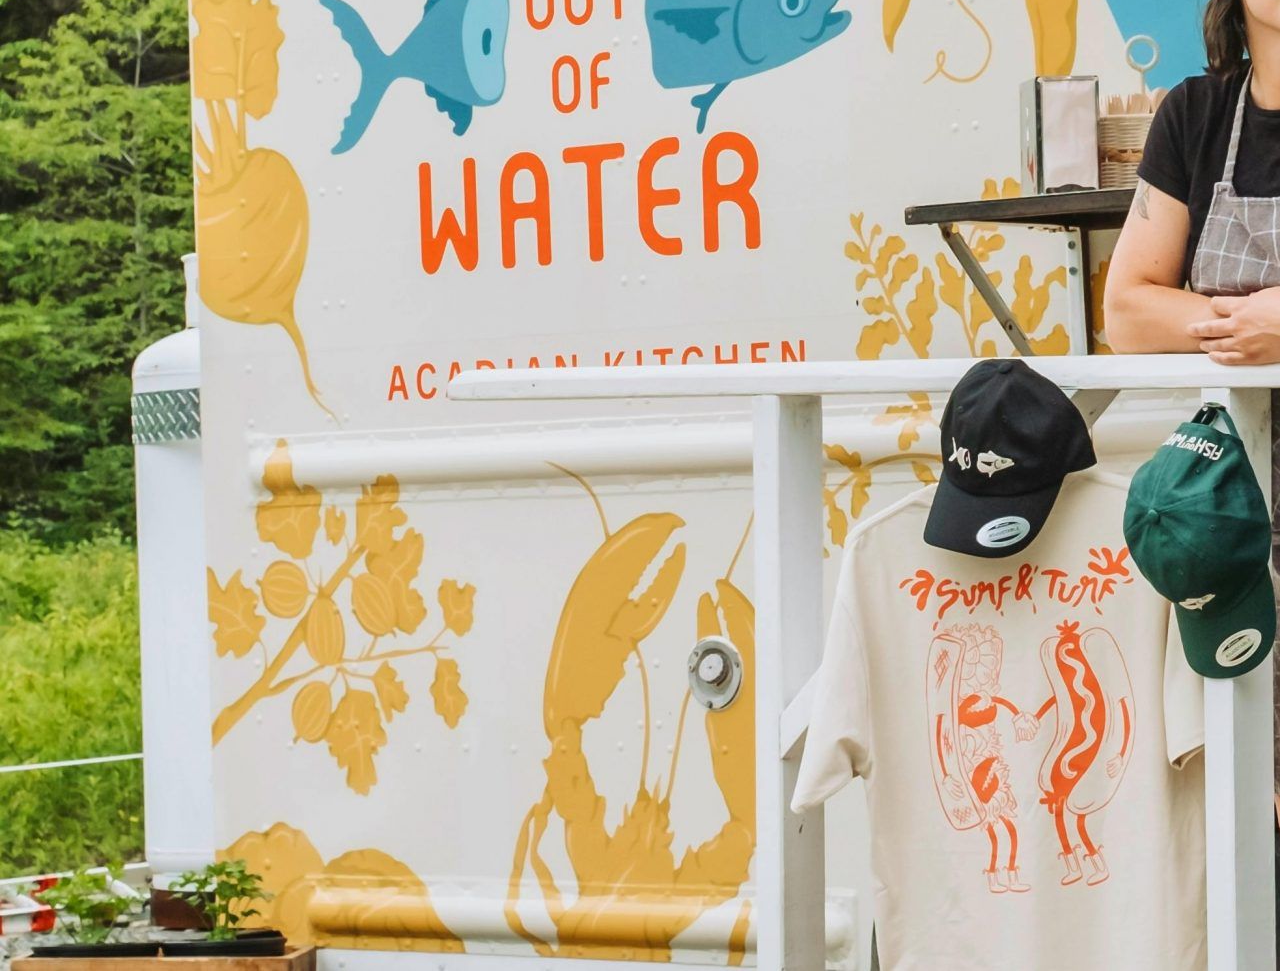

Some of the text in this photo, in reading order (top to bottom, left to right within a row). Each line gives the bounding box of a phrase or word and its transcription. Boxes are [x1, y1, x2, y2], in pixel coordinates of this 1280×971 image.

[551, 51, 611, 114] OF
[418, 131, 762, 276] WATER
[1194, 437, 1225, 460] FISH
